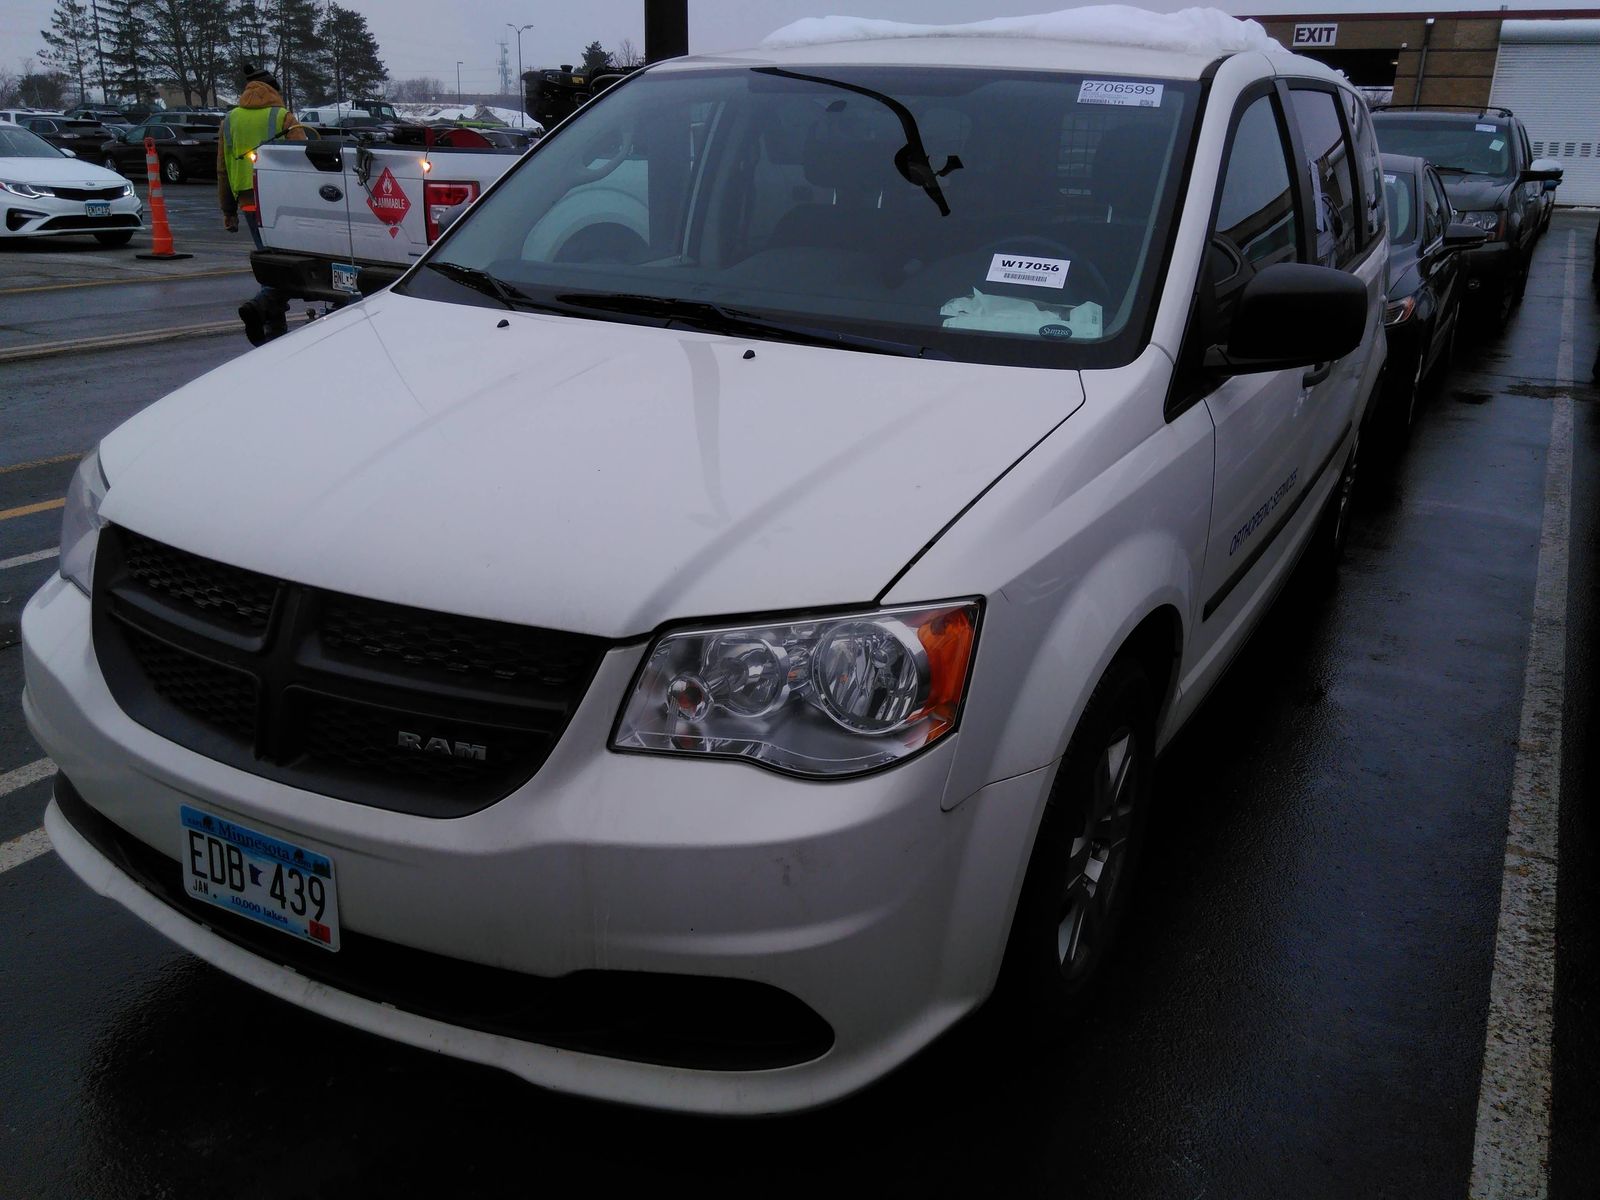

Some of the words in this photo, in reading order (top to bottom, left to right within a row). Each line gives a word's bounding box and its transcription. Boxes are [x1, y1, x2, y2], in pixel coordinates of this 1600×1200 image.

[1295, 27, 1336, 43] EXIT
[1083, 82, 1156, 95] 2706599
[372, 196, 406, 210] AMMABLE
[1001, 259, 1060, 272] W17056
[1229, 496, 1273, 556] ORTHOPEDIC
[398, 730, 487, 761] RAM
[218, 821, 290, 860] Minnesota
[188, 829, 246, 893] EDB
[270, 863, 326, 923] 439
[193, 878, 209, 895] JAN
[231, 895, 261, 913] 10,000
[263, 907, 288, 924] lakes
